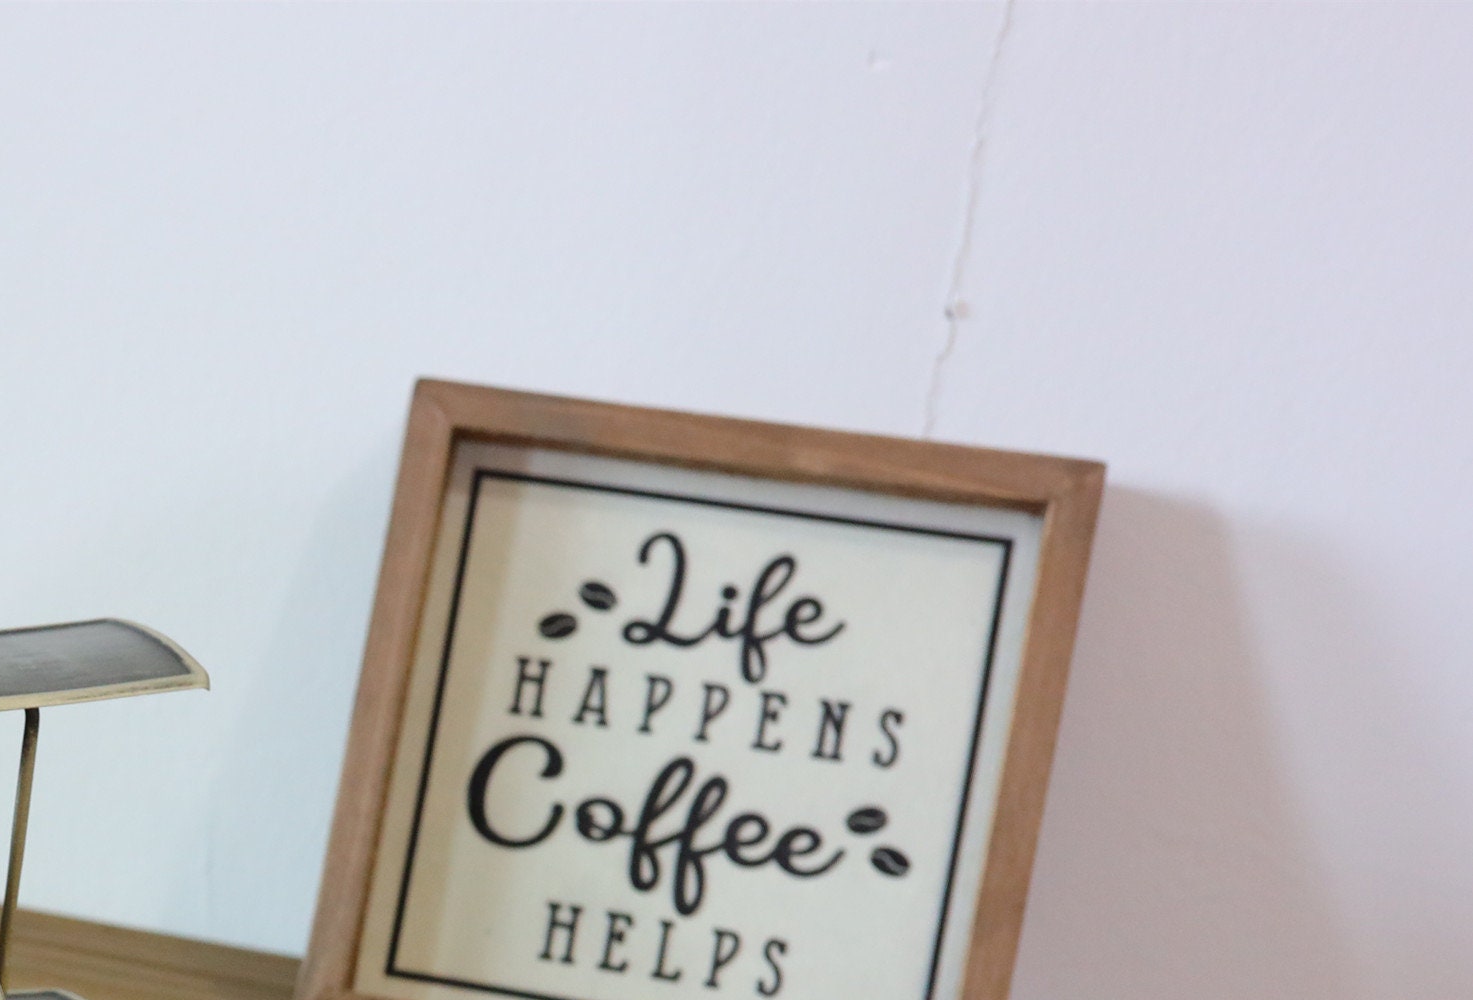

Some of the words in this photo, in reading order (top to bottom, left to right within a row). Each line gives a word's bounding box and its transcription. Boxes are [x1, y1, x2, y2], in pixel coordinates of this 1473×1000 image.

[622, 531, 846, 683] Life
[509, 655, 904, 768] HAPPENS
[466, 735, 846, 917] Coffee
[539, 903, 789, 999] HELPS
